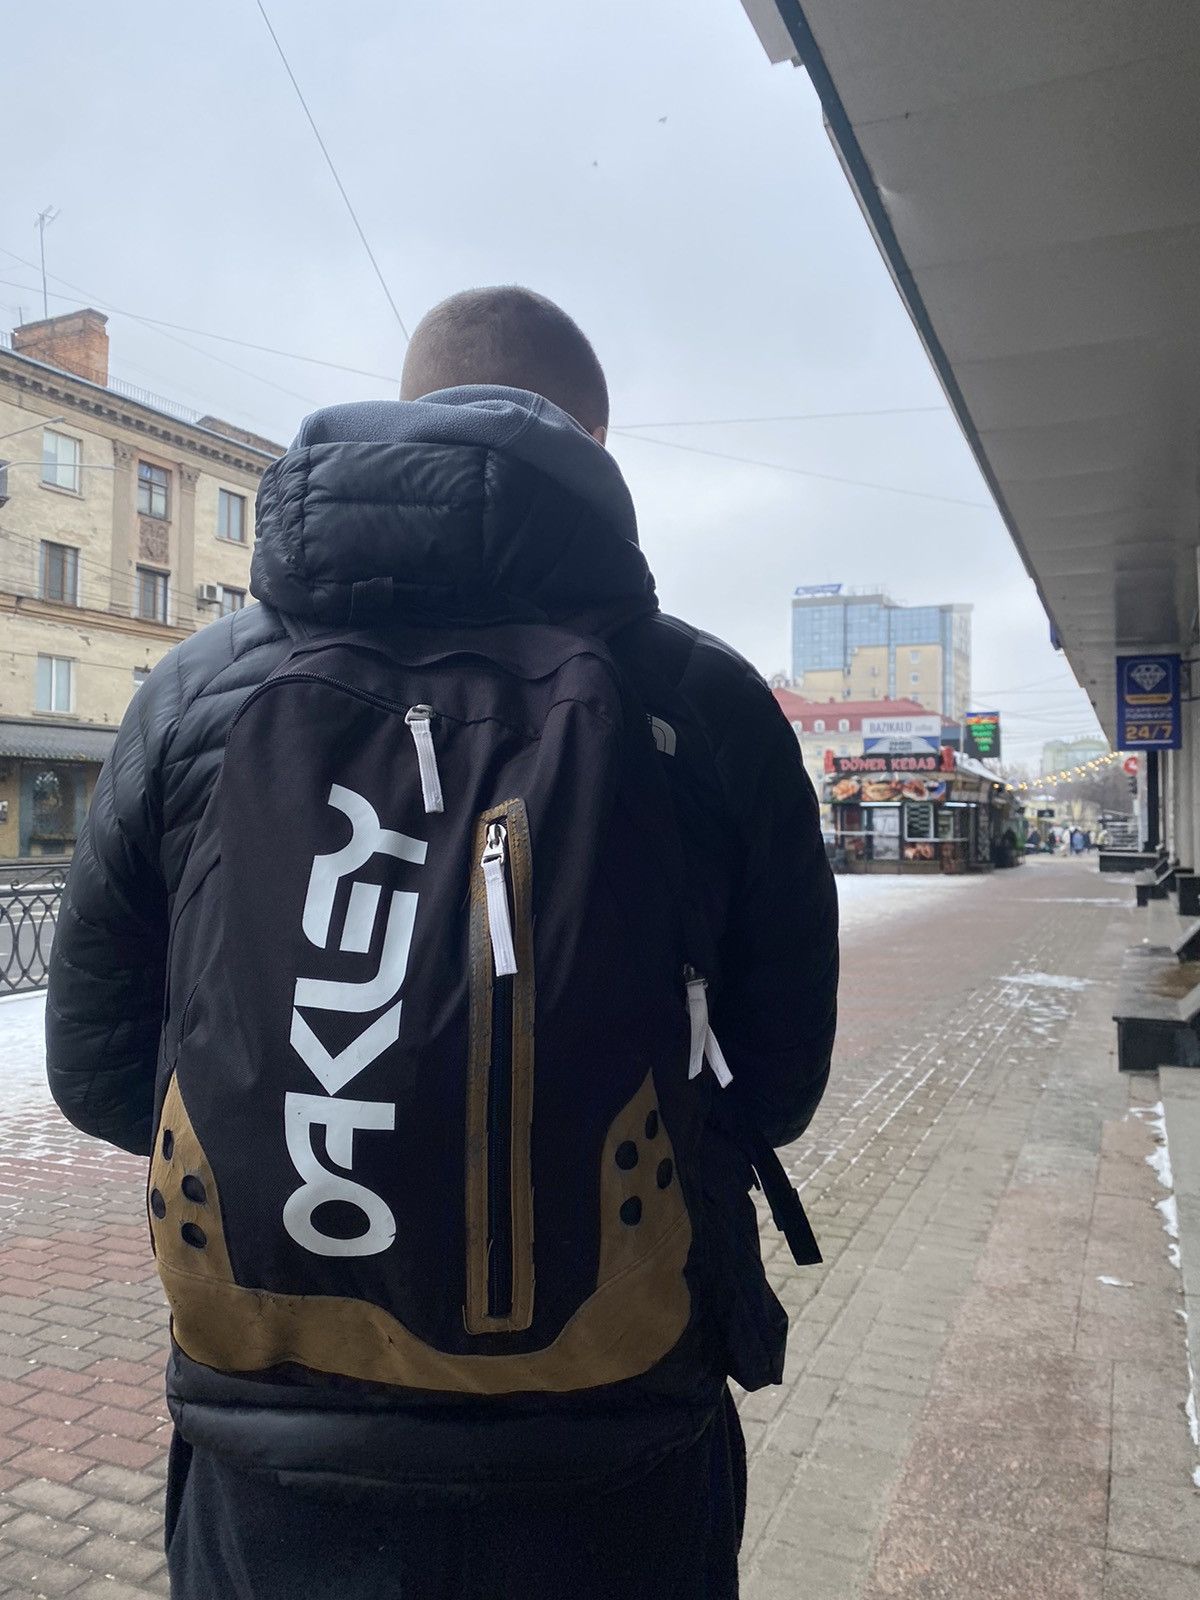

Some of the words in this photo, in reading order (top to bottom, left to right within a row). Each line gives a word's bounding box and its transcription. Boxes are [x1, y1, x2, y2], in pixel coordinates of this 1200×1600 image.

[1126, 725, 1173, 739] 24/7
[891, 756, 936, 771] KEBAB
[282, 783, 429, 1257] OAKLEY
